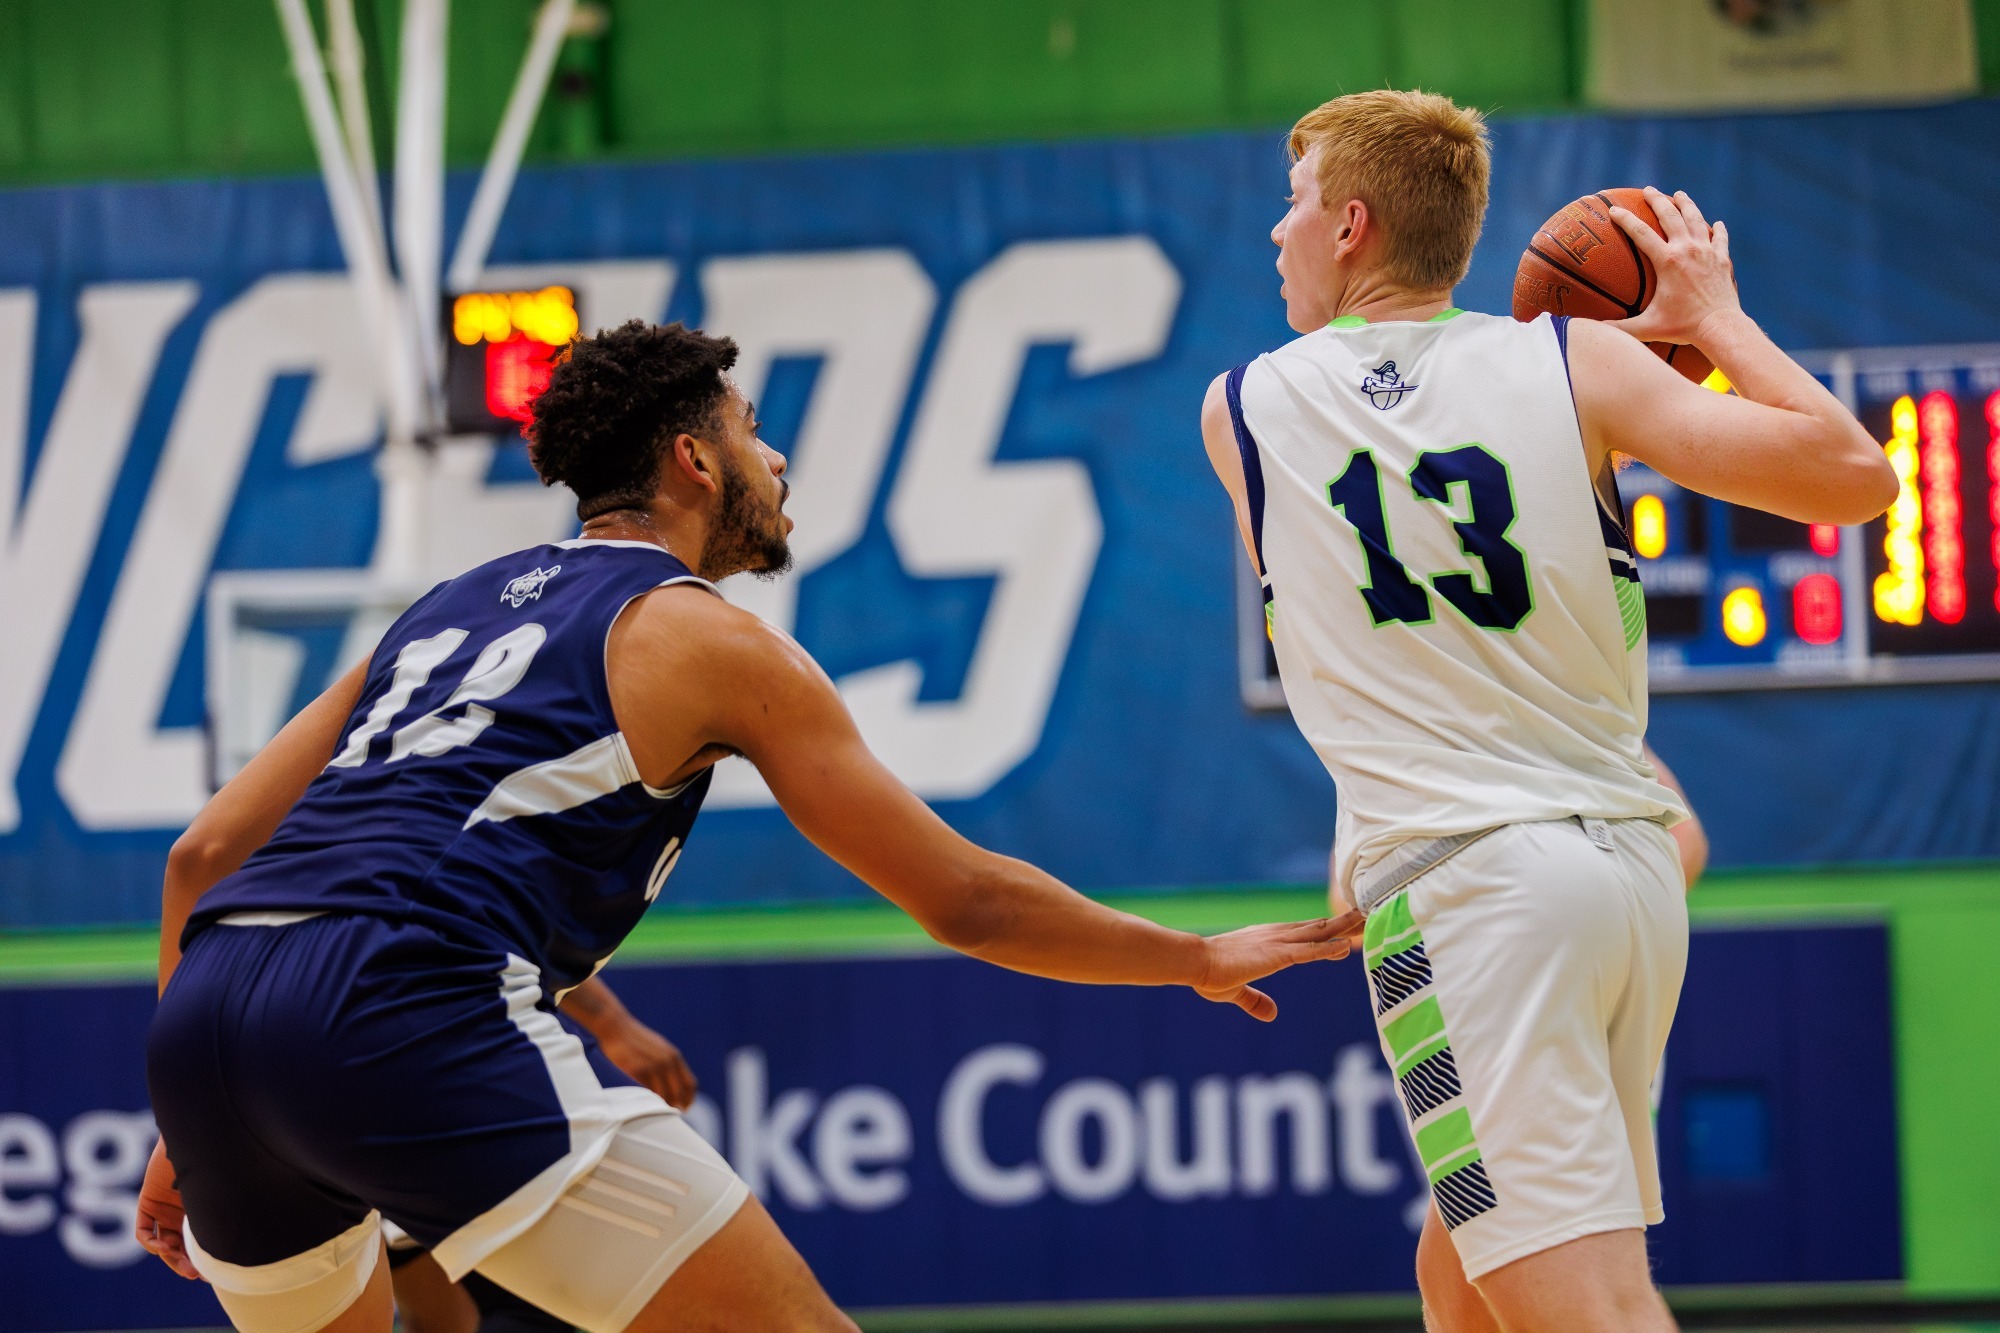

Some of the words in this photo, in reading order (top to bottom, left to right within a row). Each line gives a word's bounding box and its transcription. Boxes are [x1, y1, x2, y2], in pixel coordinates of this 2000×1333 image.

[1325, 442, 1536, 634] 13
[328, 622, 547, 766] 12
[936, 1042, 1426, 1232] Count
